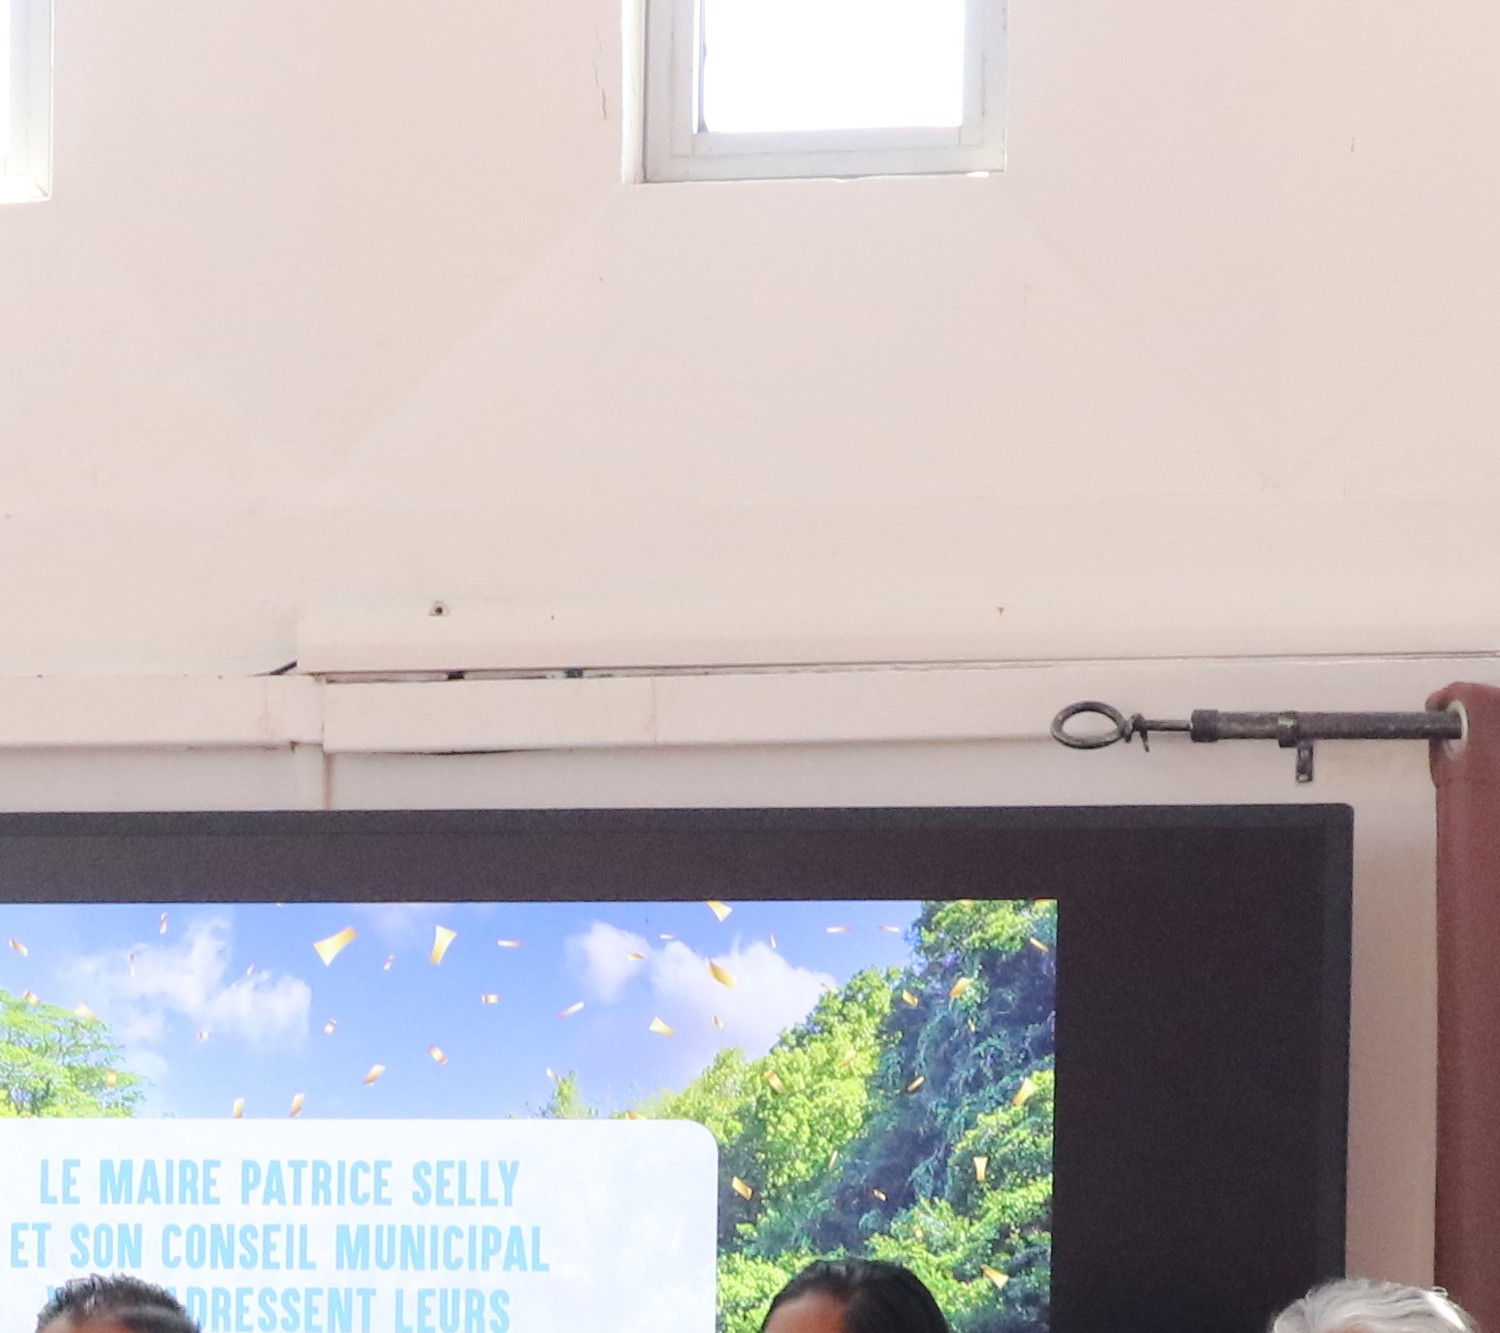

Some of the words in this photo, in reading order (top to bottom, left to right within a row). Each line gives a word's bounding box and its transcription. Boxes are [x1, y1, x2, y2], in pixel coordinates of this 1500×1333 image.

[39, 1158, 82, 1206] LE
[100, 1158, 222, 1206] MAIRE
[241, 1159, 390, 1207] PATRICE
[412, 1160, 520, 1208] SELLY
[11, 1222, 53, 1269] ET
[70, 1222, 143, 1270] SON
[161, 1223, 318, 1272] CONSEIL
[336, 1224, 550, 1273] MUNICIPAL
